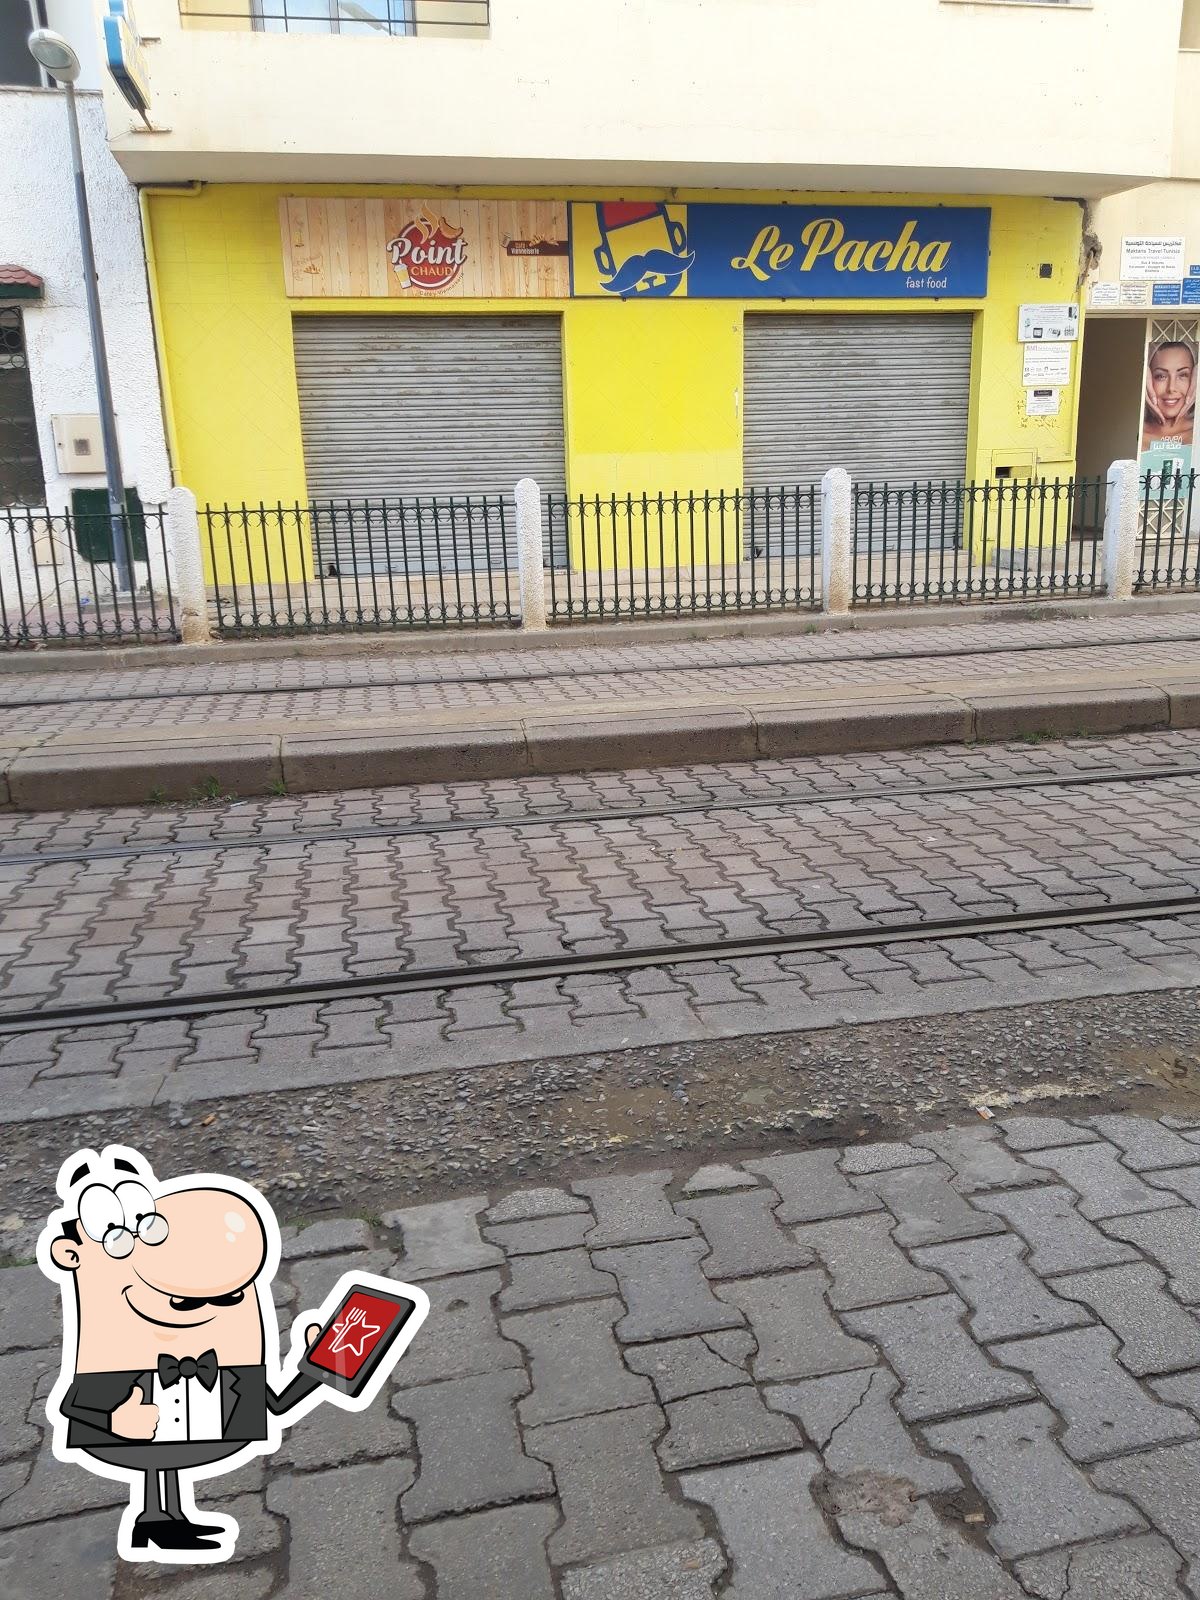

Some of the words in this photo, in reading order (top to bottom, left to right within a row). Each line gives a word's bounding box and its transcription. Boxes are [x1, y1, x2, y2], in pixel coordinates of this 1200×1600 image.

[386, 236, 468, 266] Point
[730, 225, 794, 281] Le
[799, 217, 952, 273] Pacha
[410, 266, 453, 277] CHAUD
[906, 276, 924, 289] fast
[926, 276, 948, 289] food
